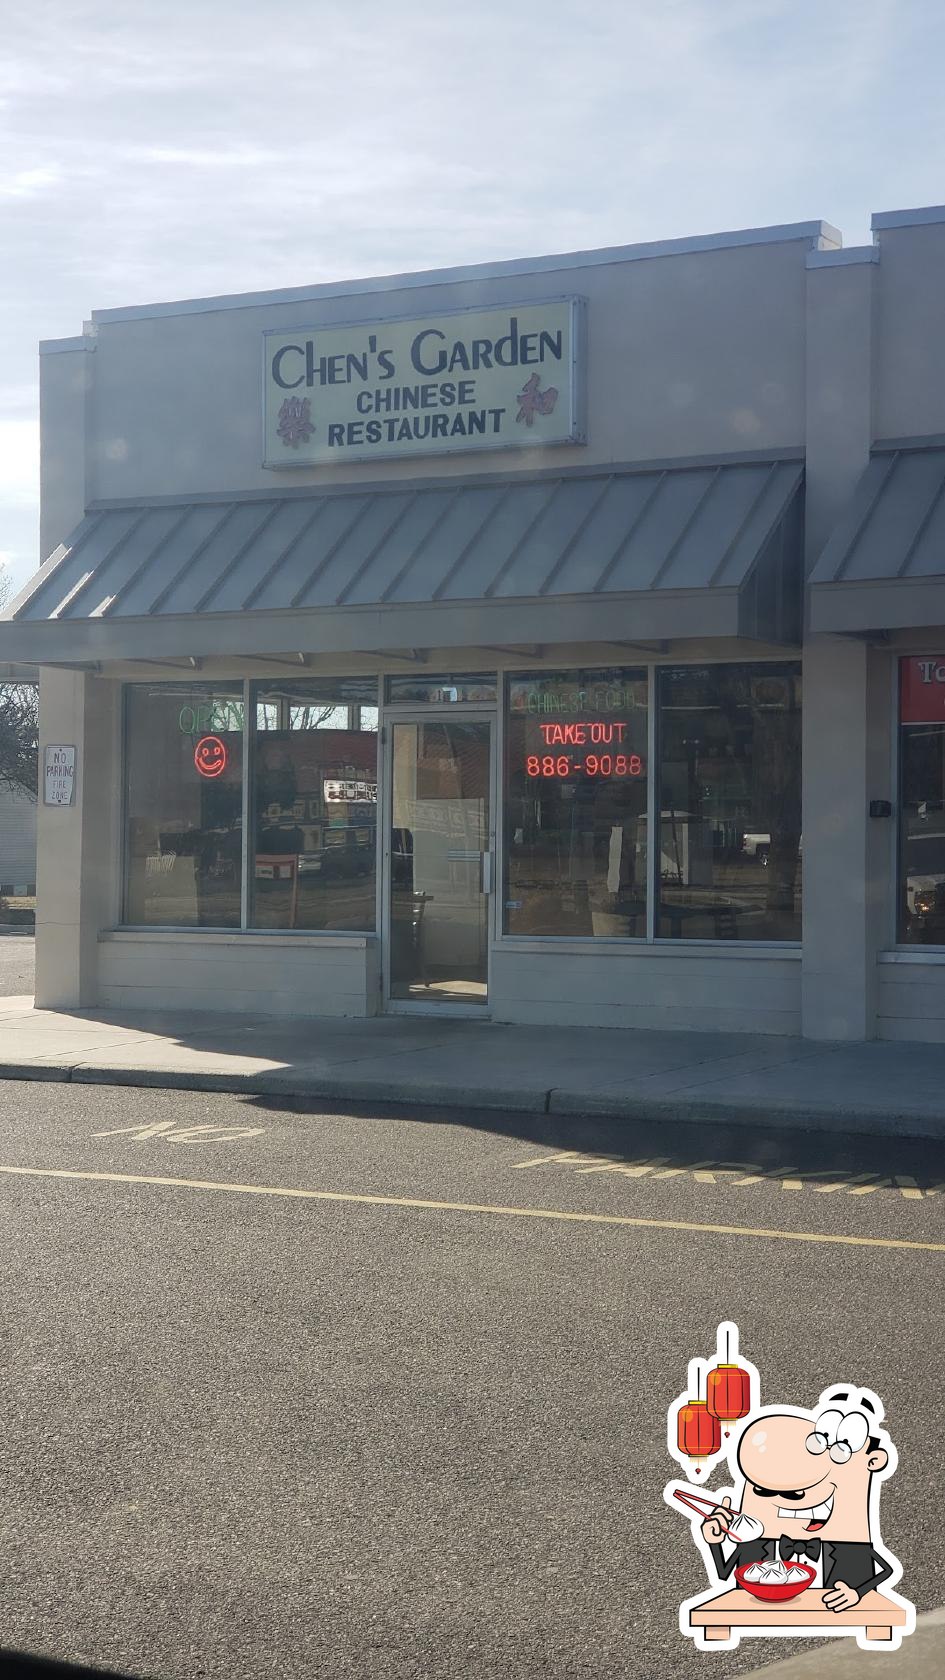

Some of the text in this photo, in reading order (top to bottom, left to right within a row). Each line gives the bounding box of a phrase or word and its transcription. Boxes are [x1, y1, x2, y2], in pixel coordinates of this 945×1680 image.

[356, 380, 477, 414] CHINESE
[328, 408, 506, 447] RESTAURANT
[179, 701, 245, 734] OPEN
[540, 722, 627, 745] TAKE OUT
[53, 752, 67, 764] NO
[527, 754, 641, 777] 886-9088
[46, 765, 74, 778] PARKING
[51, 791, 68, 800] ZONE
[53, 780, 66, 789] FIRE
[90, 1121, 266, 1144] NO
